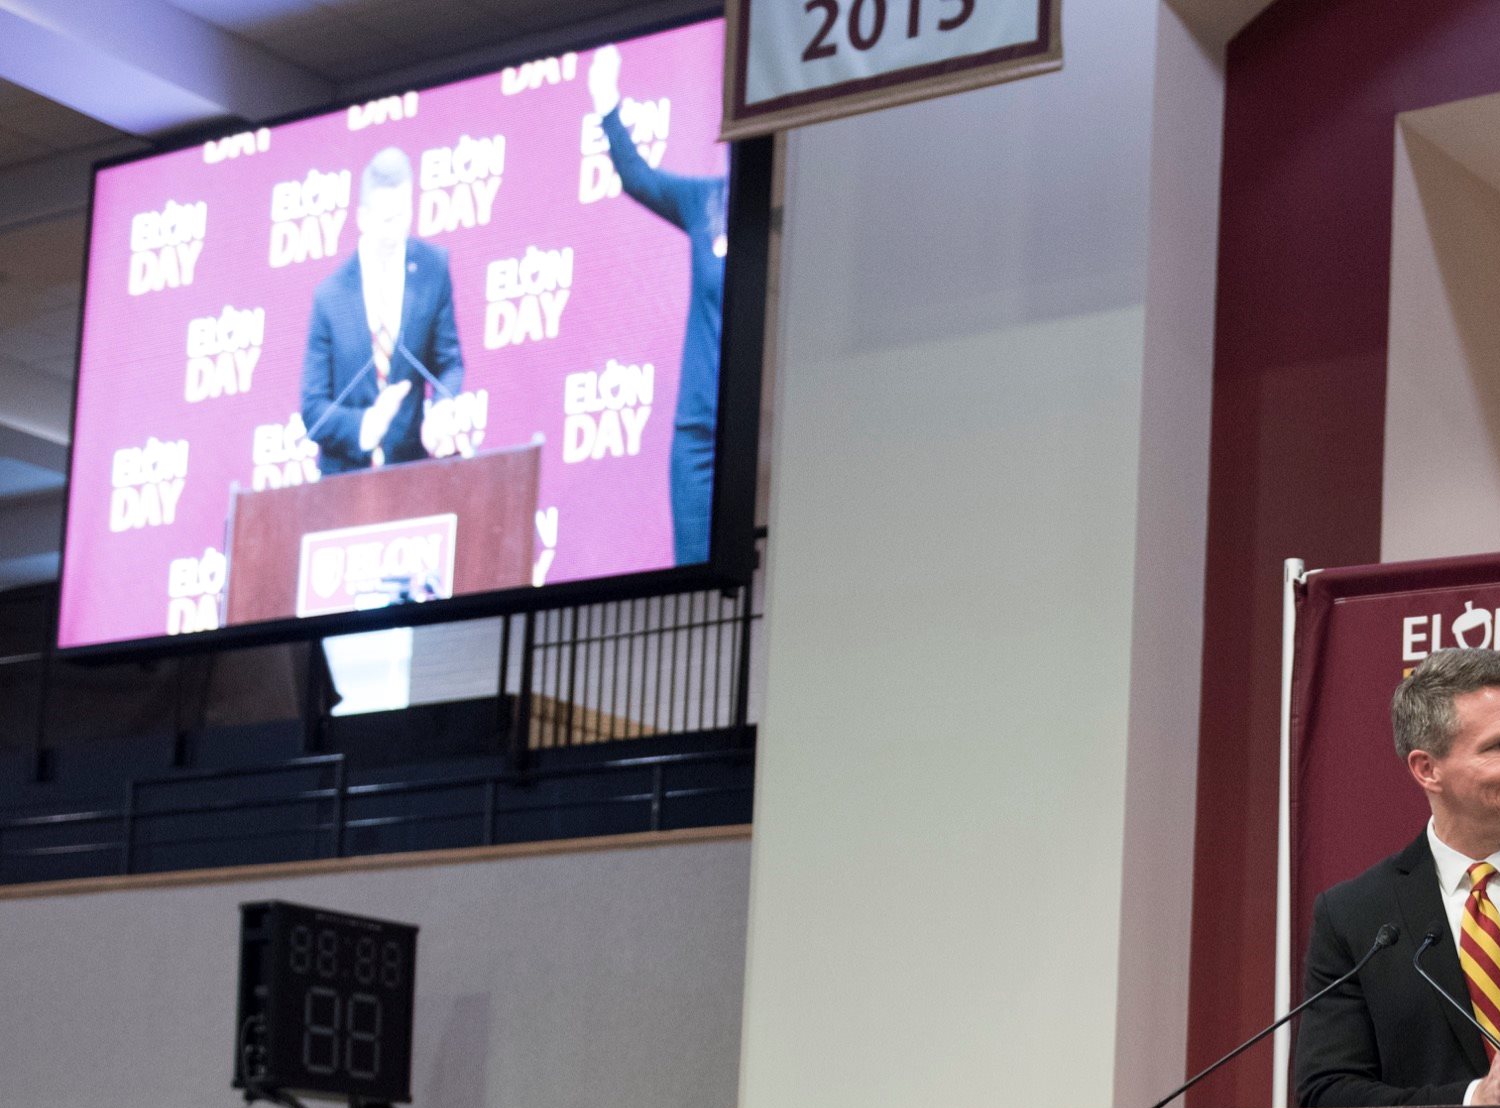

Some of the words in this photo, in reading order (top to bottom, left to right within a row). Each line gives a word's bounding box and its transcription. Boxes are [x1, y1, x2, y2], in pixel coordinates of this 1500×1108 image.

[419, 133, 506, 191] ELON
[270, 168, 352, 224] ELON
[418, 174, 503, 237] DAY
[130, 199, 208, 252] ELON
[268, 207, 348, 268] DAY
[128, 239, 204, 296] DAY
[486, 245, 574, 302] ELON
[187, 304, 265, 359] ELON
[484, 288, 571, 350] DAY
[185, 345, 262, 403] DAY
[564, 358, 655, 415] ELON
[112, 436, 189, 489] ELON
[562, 405, 651, 464] DAY
[110, 478, 185, 533] DAY
[168, 546, 227, 599] ELO
[166, 592, 220, 635] DA
